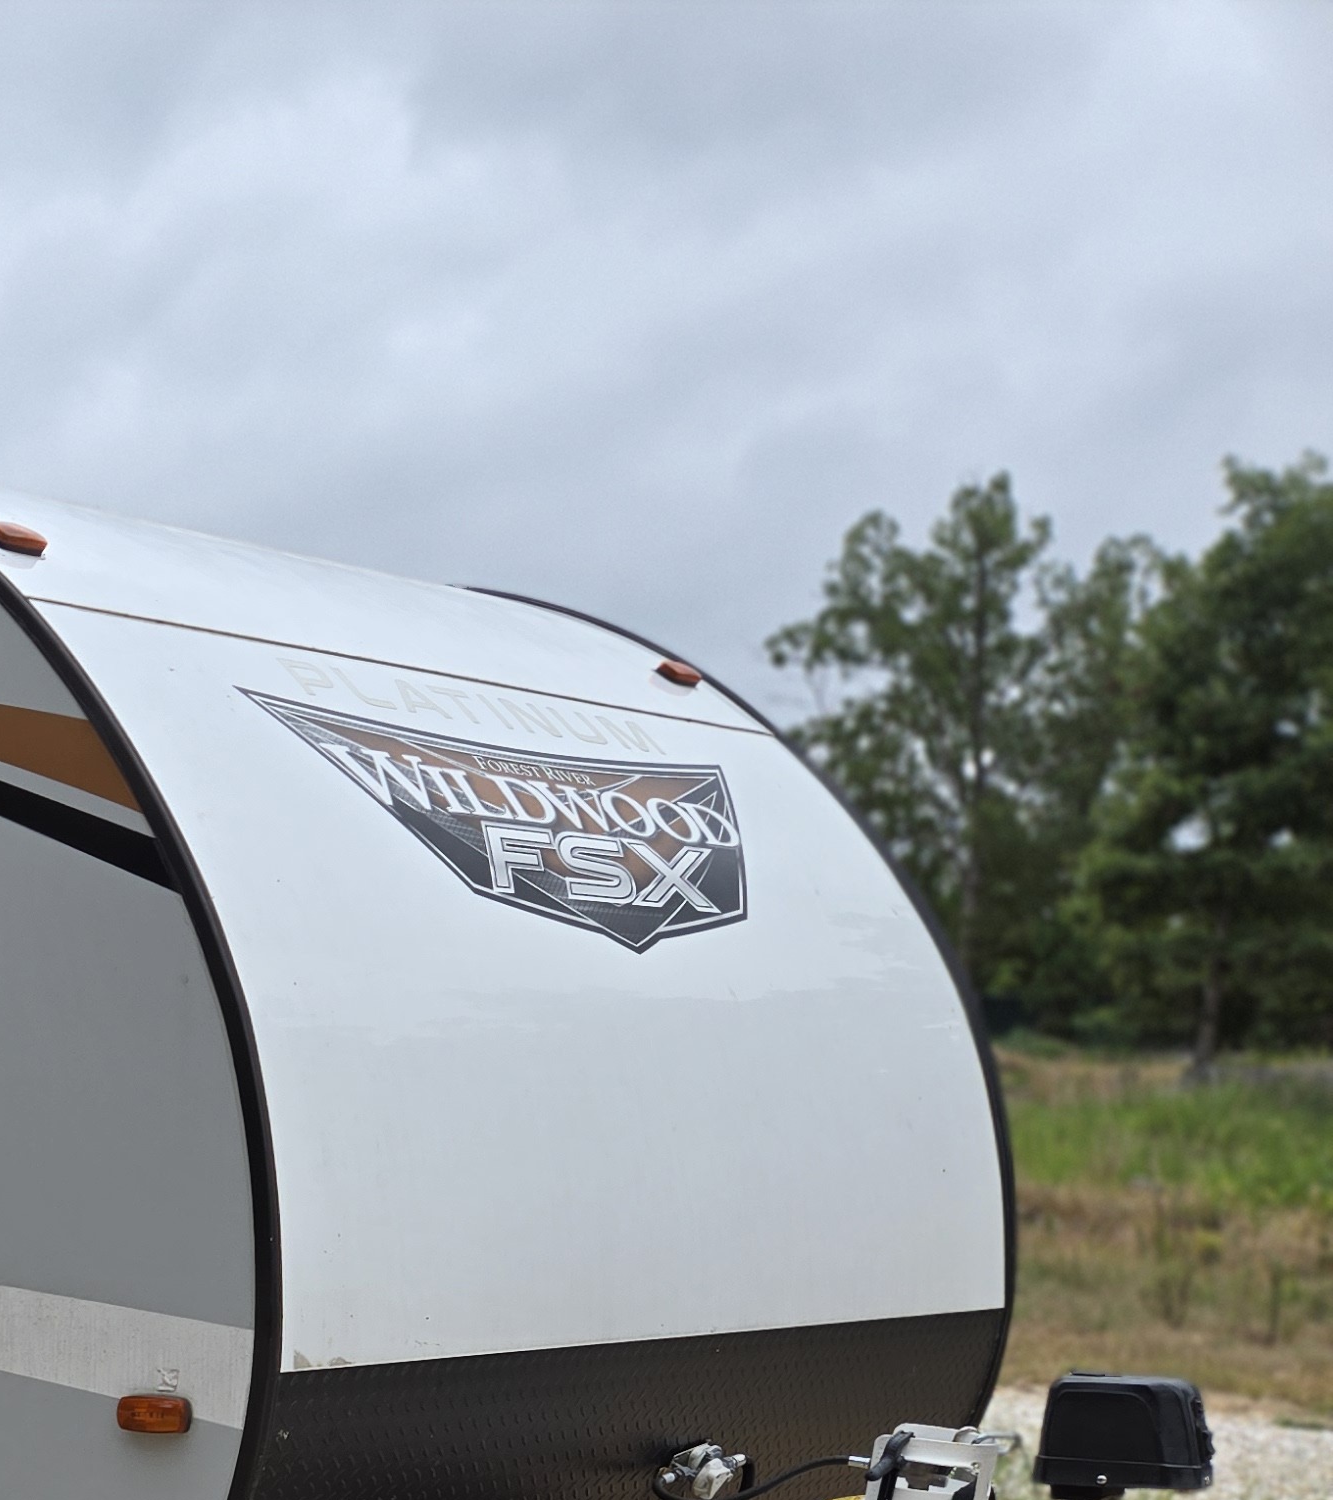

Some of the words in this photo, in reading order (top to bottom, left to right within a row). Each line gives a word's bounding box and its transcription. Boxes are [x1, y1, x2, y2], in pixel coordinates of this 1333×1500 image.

[276, 657, 667, 756] PLATINUM
[319, 742, 741, 848] WILDWOOD
[472, 755, 542, 779] FOREST
[540, 765, 597, 787] RIVER
[481, 820, 722, 914] FSX
